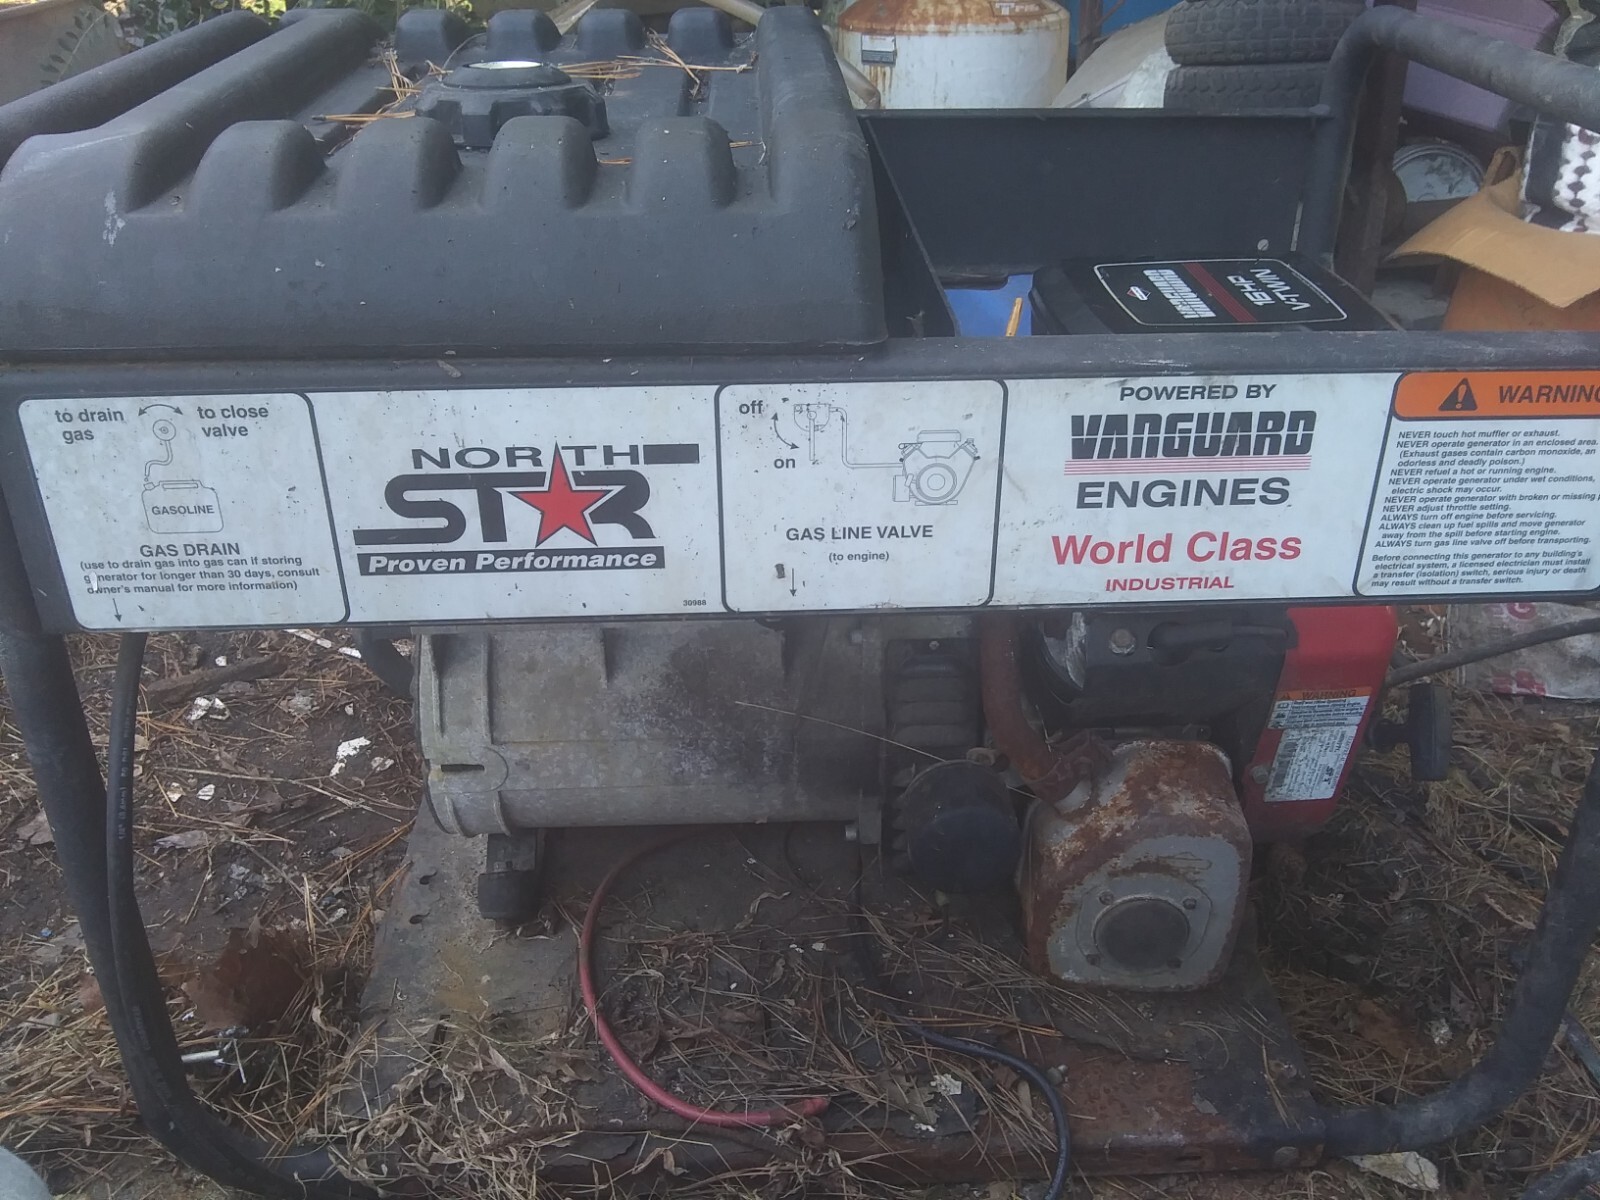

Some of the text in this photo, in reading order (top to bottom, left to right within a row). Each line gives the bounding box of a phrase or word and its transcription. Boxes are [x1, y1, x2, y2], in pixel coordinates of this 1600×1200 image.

[1120, 384, 1277, 401] POWERED BY
[197, 405, 268, 419] to close
[739, 400, 763, 414] off
[54, 408, 124, 423] to drain
[201, 423, 248, 437] valve
[1071, 410, 1317, 460] VANGUARD
[1398, 431, 1431, 439] NEVER
[62, 429, 94, 445] gas
[1431, 440, 1465, 449] operate
[1467, 440, 1511, 449] generator
[411, 445, 640, 469] NORTH
[1400, 450, 1440, 459] (Exhaust
[1441, 451, 1468, 459] gases
[1470, 448, 1503, 456] contain
[774, 458, 795, 469] on
[1458, 458, 1487, 467] deadly
[1488, 458, 1525, 467] poison.)
[1390, 468, 1423, 476] NEVER
[1488, 467, 1523, 476] running
[1524, 466, 1556, 476] engine.
[1388, 477, 1421, 485] NEVER
[1422, 477, 1456, 486] operate
[1458, 476, 1501, 486] generator
[1076, 477, 1290, 509] ENGINES
[1391, 486, 1424, 494] electric
[1384, 496, 1417, 504] NEVER
[1418, 496, 1452, 504] operate
[1454, 495, 1497, 504] generator
[1562, 493, 1596, 501] missing
[152, 505, 214, 515] GASOLINE
[1416, 504, 1444, 513] adjust
[1479, 503, 1511, 512] setting.
[1380, 513, 1418, 521] ALWAYS
[1454, 513, 1484, 521] engine
[1516, 511, 1556, 520] servicing.
[1378, 522, 1416, 530] ALWAYS
[1475, 521, 1499, 530] spills
[1544, 520, 1586, 529] generator
[786, 525, 933, 542] GAS LINE VALVE
[1444, 530, 1463, 539] spill
[1494, 529, 1528, 538] starting
[1529, 528, 1560, 537] engine.
[1052, 531, 1302, 565] World Class
[1374, 539, 1412, 548] ALWAYS
[1537, 536, 1591, 545] transporting.
[140, 542, 240, 557] GAS DRAIN
[1402, 553, 1451, 561] connecting
[1471, 552, 1513, 561] generator
[1542, 550, 1583, 558] building's
[80, 561, 105, 571] (use
[107, 560, 119, 569] to
[122, 559, 151, 568] drain
[154, 560, 175, 570] gas
[177, 558, 200, 567] into
[203, 559, 224, 569] gas
[250, 557, 258, 565] if
[262, 556, 302, 566] storing
[368, 552, 657, 573] Proven Performance
[829, 551, 889, 564] (to engine)
[1416, 562, 1449, 571] system,
[84, 568, 320, 584] gnerator for longer than 30 days, consult
[1380, 571, 1415, 579] transfer
[1416, 570, 1459, 579] (isolation)
[133, 583, 175, 593] manual
[177, 583, 193, 592] for
[228, 580, 297, 591] information)
[1106, 576, 1234, 592] INDUSTRIAL
